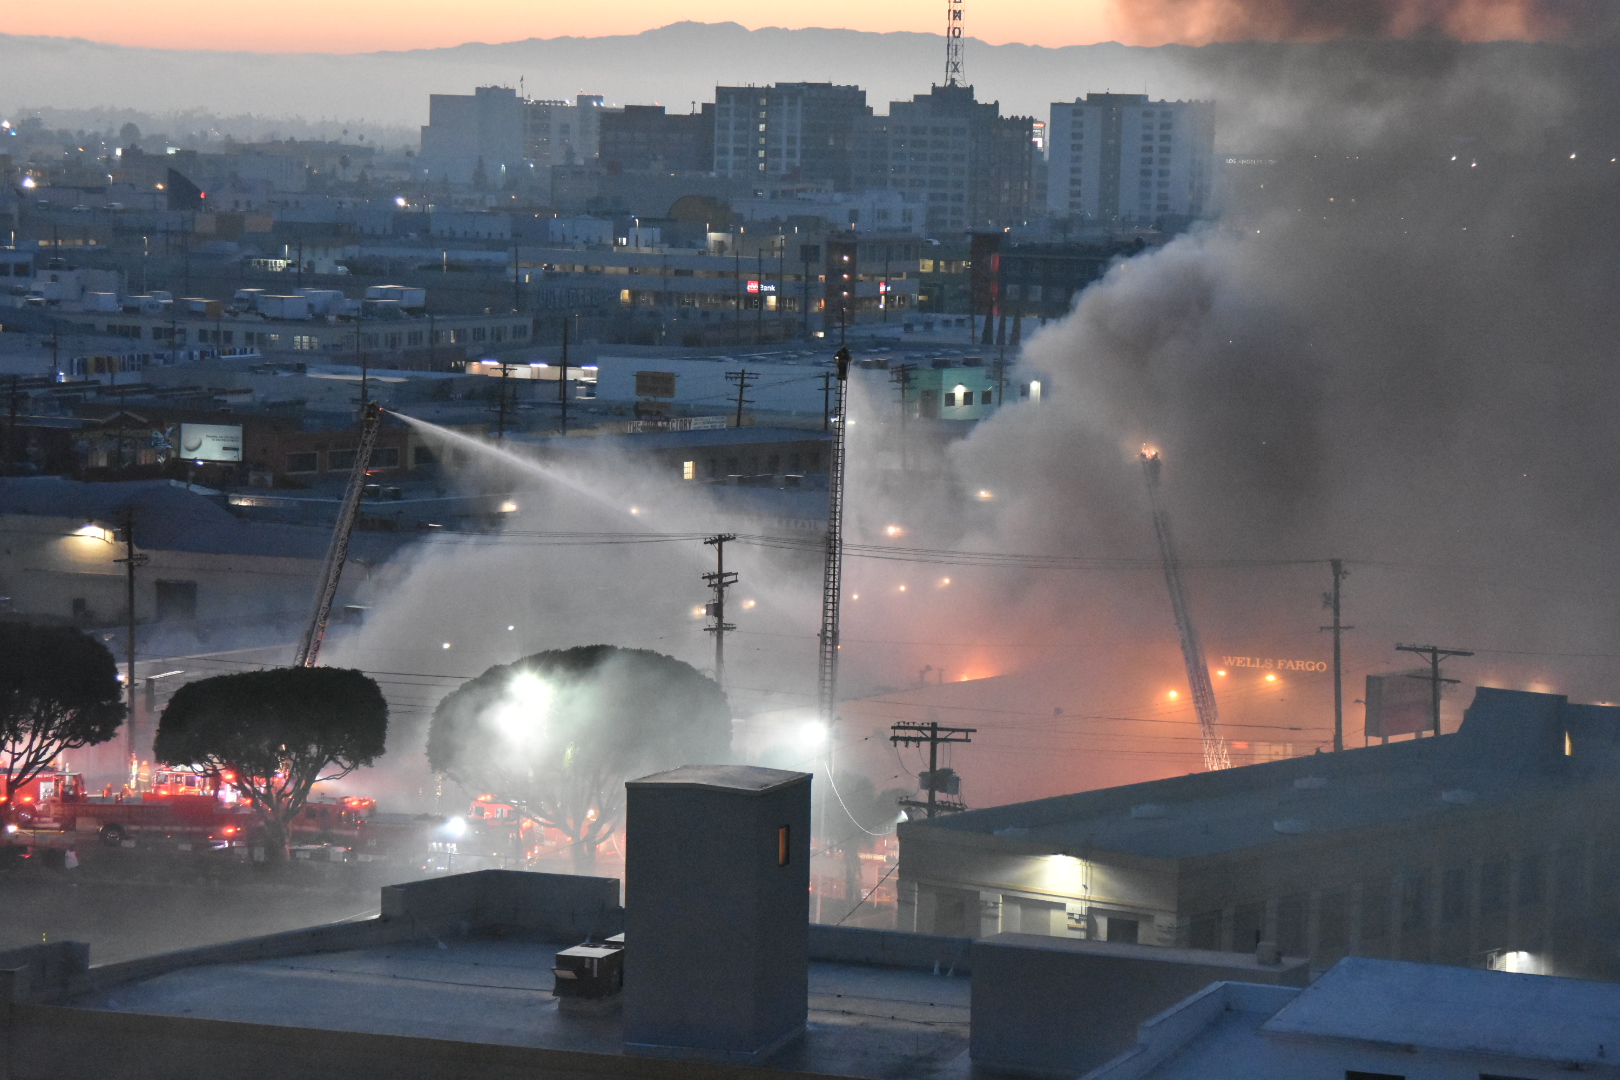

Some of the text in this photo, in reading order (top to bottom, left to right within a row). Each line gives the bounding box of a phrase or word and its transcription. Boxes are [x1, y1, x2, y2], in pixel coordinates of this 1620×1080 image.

[760, 284, 776, 292] Bank
[1222, 655, 1327, 672] WELLS FARGO
[367, 838, 377, 847] 14
